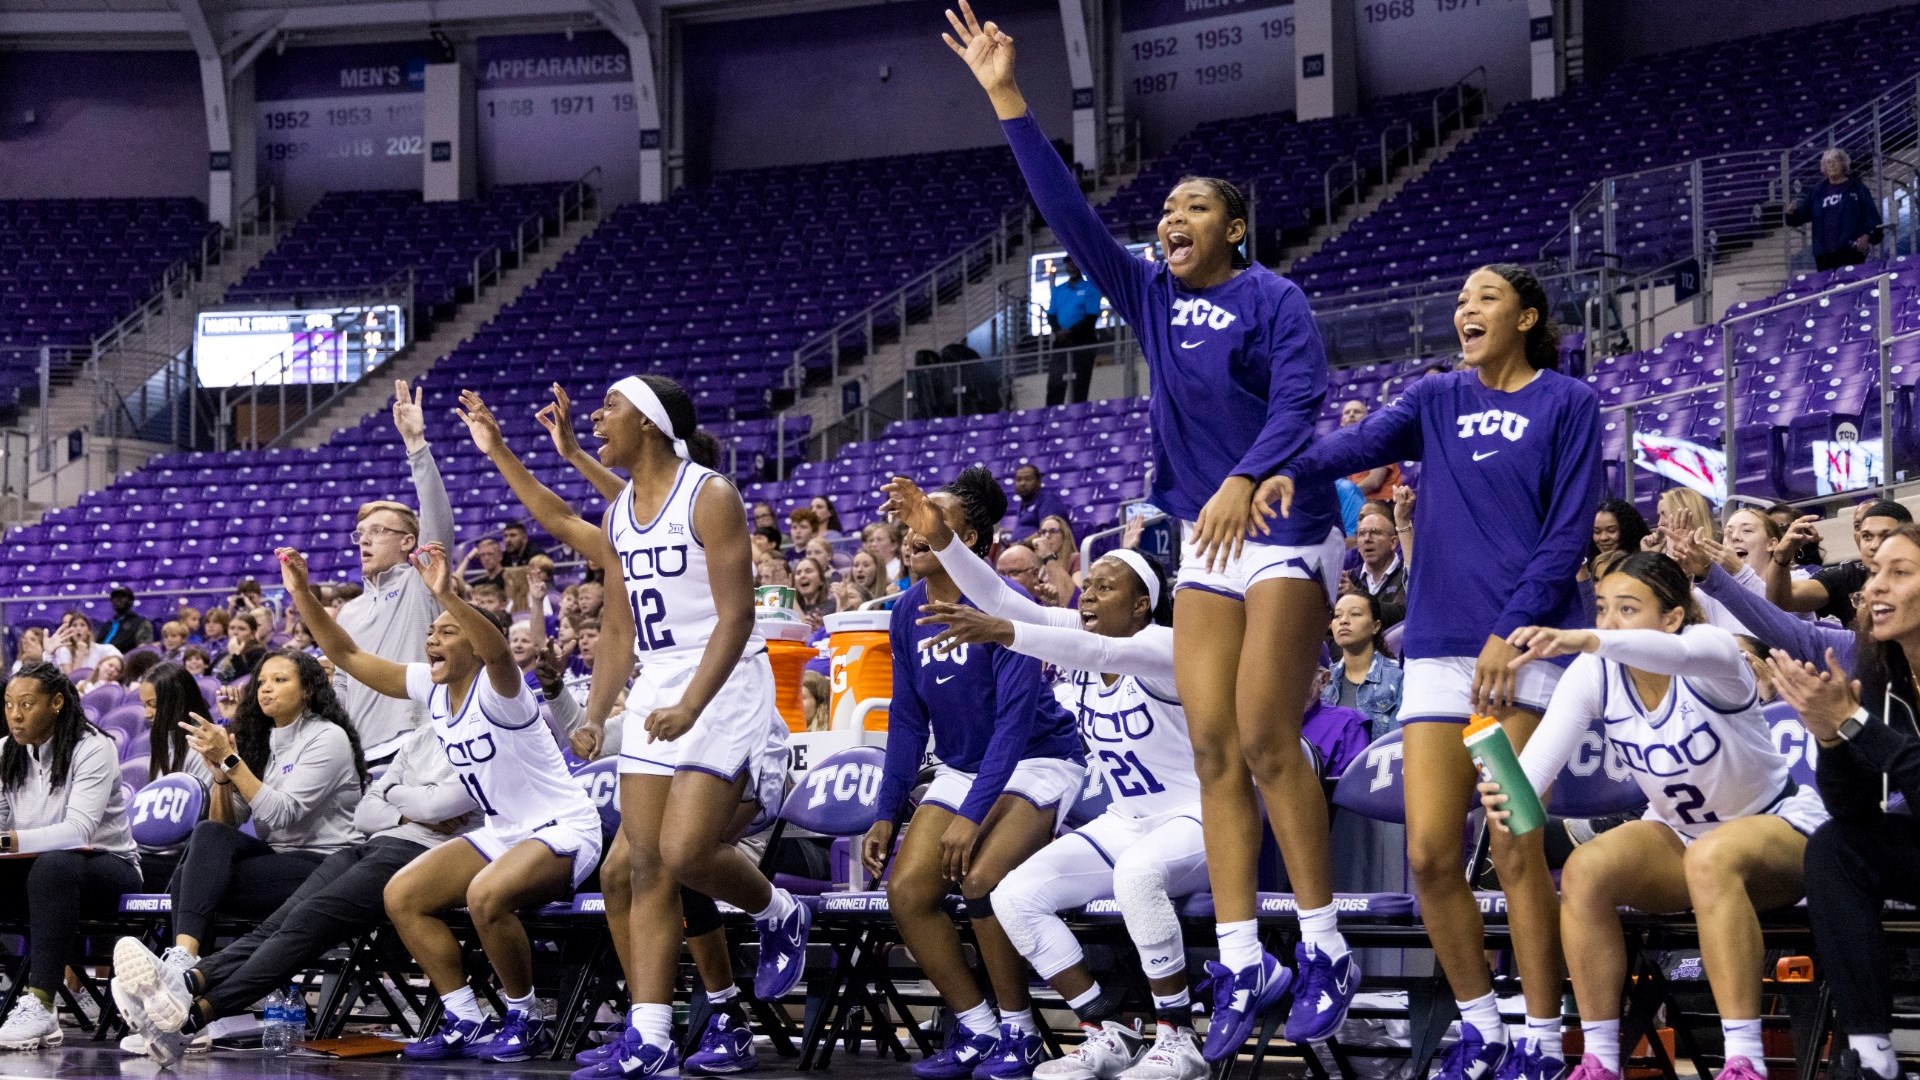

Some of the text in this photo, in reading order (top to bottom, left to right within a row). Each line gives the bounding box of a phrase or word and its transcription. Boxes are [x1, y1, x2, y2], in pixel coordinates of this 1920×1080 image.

[1365, 0, 1415, 23] 1968
[1131, 37, 1178, 61] 1952
[1195, 27, 1243, 50] 1953
[340, 66, 400, 88] MEN'S
[485, 53, 627, 80] APPEARANCES
[1133, 62, 1243, 95] 1987 1998
[266, 110, 310, 131] 1952
[327, 107, 372, 127] 1953
[487, 99, 534, 118] 168
[550, 96, 594, 116] 1971
[1680, 272, 1694, 290] 112
[1171, 298, 1236, 331] TCU
[1457, 409, 1530, 442] TCU
[1838, 430, 1856, 440] TCU
[631, 588, 676, 651] 12
[830, 654, 848, 694] G
[1608, 721, 1721, 777] TCU
[806, 762, 884, 810] TCU
[1098, 750, 1166, 798] 21
[132, 786, 191, 826] TCU
[459, 772, 499, 816] 11
[1663, 782, 1719, 825] 2
[126, 899, 158, 911] HORNED
[826, 898, 865, 910] HORNED
[1671, 966, 1701, 981] TCU
